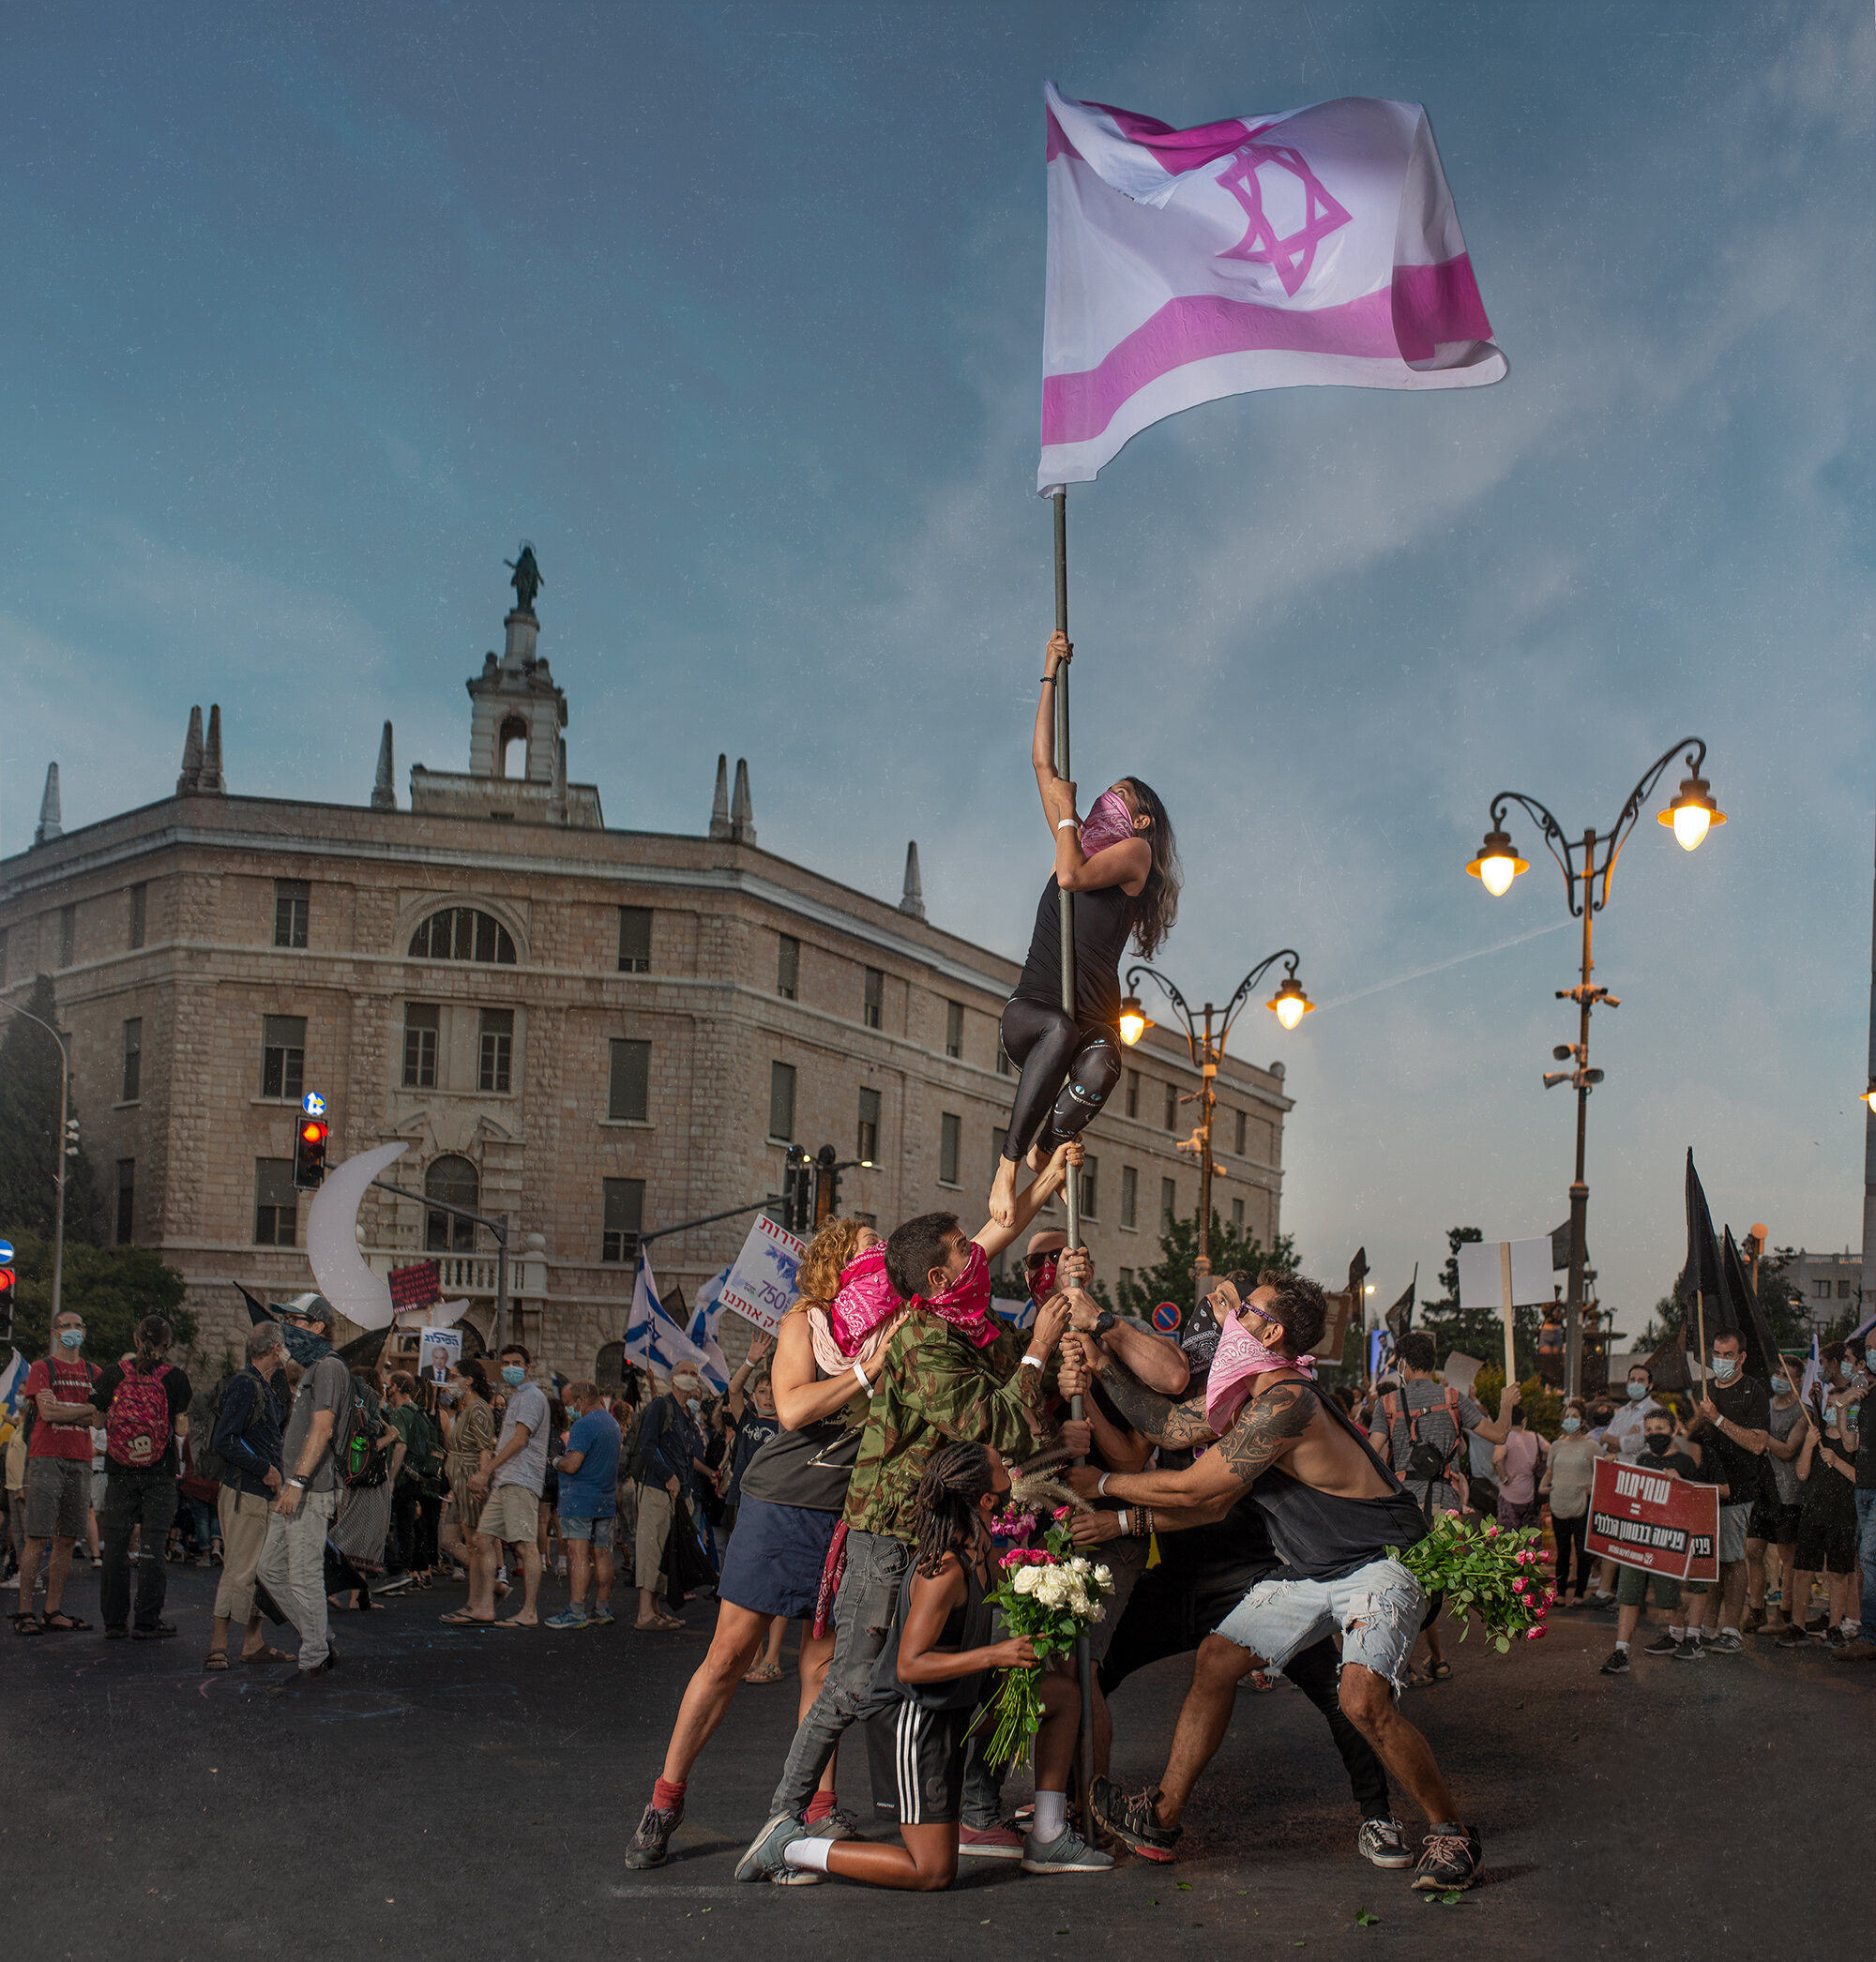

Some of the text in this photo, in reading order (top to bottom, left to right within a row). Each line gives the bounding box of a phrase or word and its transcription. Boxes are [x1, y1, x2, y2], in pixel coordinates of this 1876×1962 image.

[723, 1290, 763, 1321] אותנו
[758, 1280, 786, 1309] 750
[424, 1332, 460, 1347] הפילוג
[1614, 1470, 1671, 1505] שחיתות
[1595, 1513, 1687, 1550] פגיעה בבטחון הכלכלי
